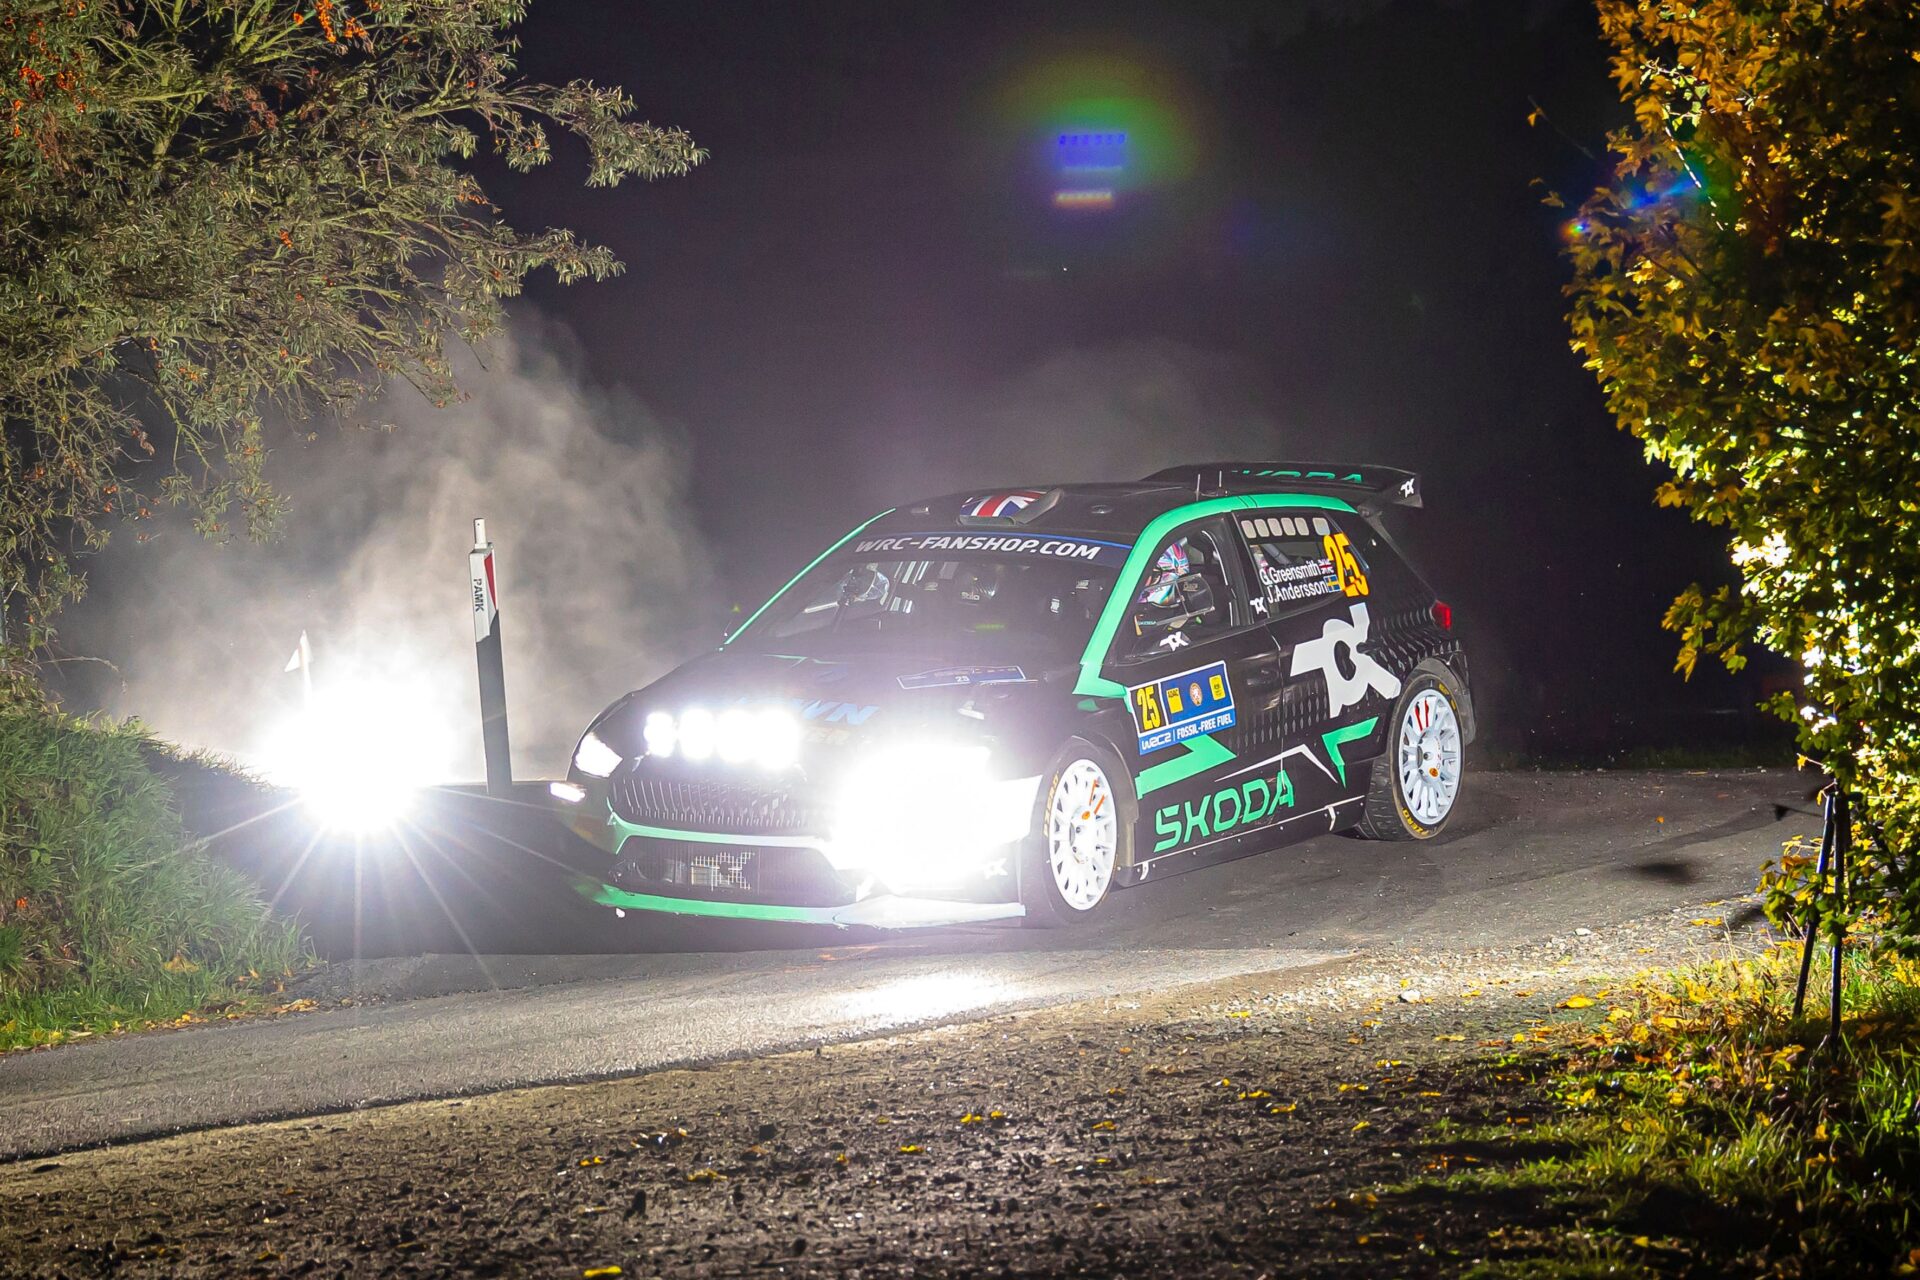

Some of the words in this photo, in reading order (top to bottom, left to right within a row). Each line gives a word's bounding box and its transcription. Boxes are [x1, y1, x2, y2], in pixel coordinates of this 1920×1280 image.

[855, 536, 1101, 560] WRC-FANSHOP.COM
[1323, 532, 1369, 597] 25
[1136, 685, 1161, 730] 25
[1176, 718, 1217, 740] FOSSIL-FREE
[1216, 713, 1233, 728] FUEL
[1153, 770, 1295, 853] SKODA
